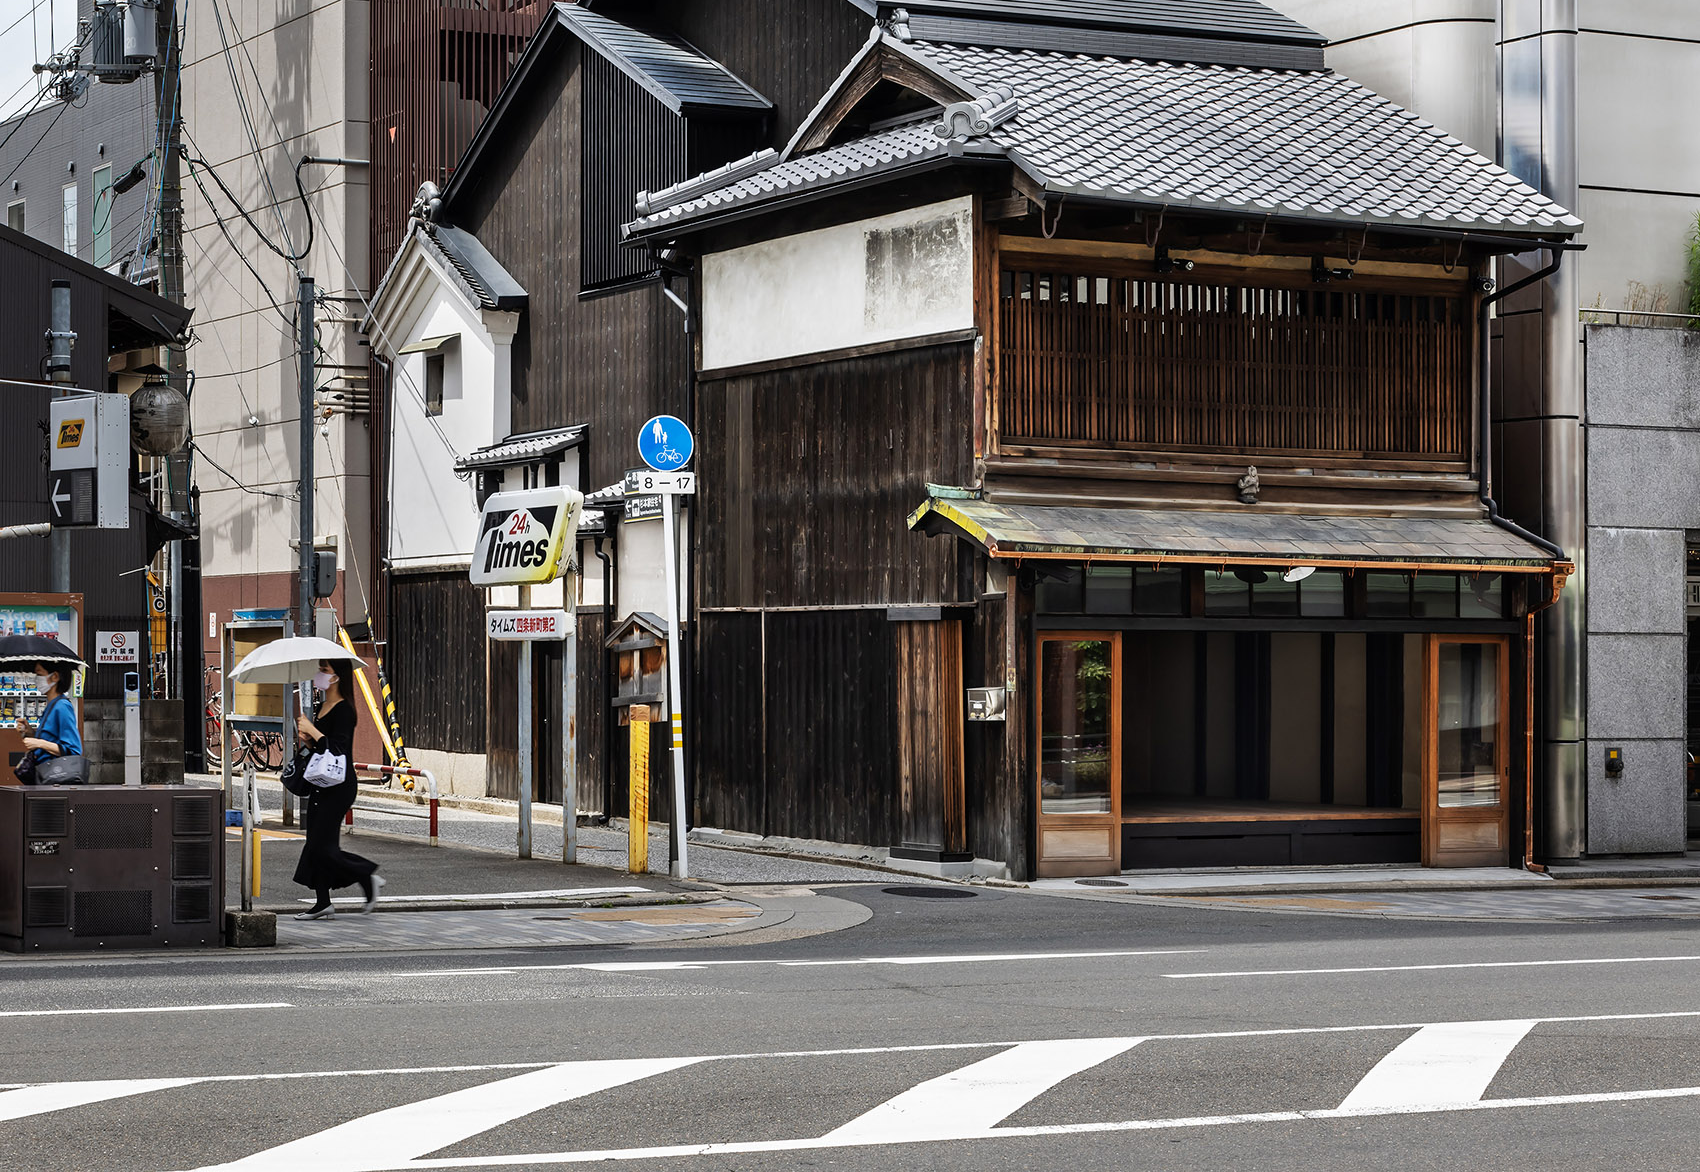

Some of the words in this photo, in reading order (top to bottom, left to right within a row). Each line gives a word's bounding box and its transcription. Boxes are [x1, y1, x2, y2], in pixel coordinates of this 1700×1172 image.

[644, 477, 654, 489] 8
[676, 477, 691, 489] 17
[483, 529, 549, 574] Times
